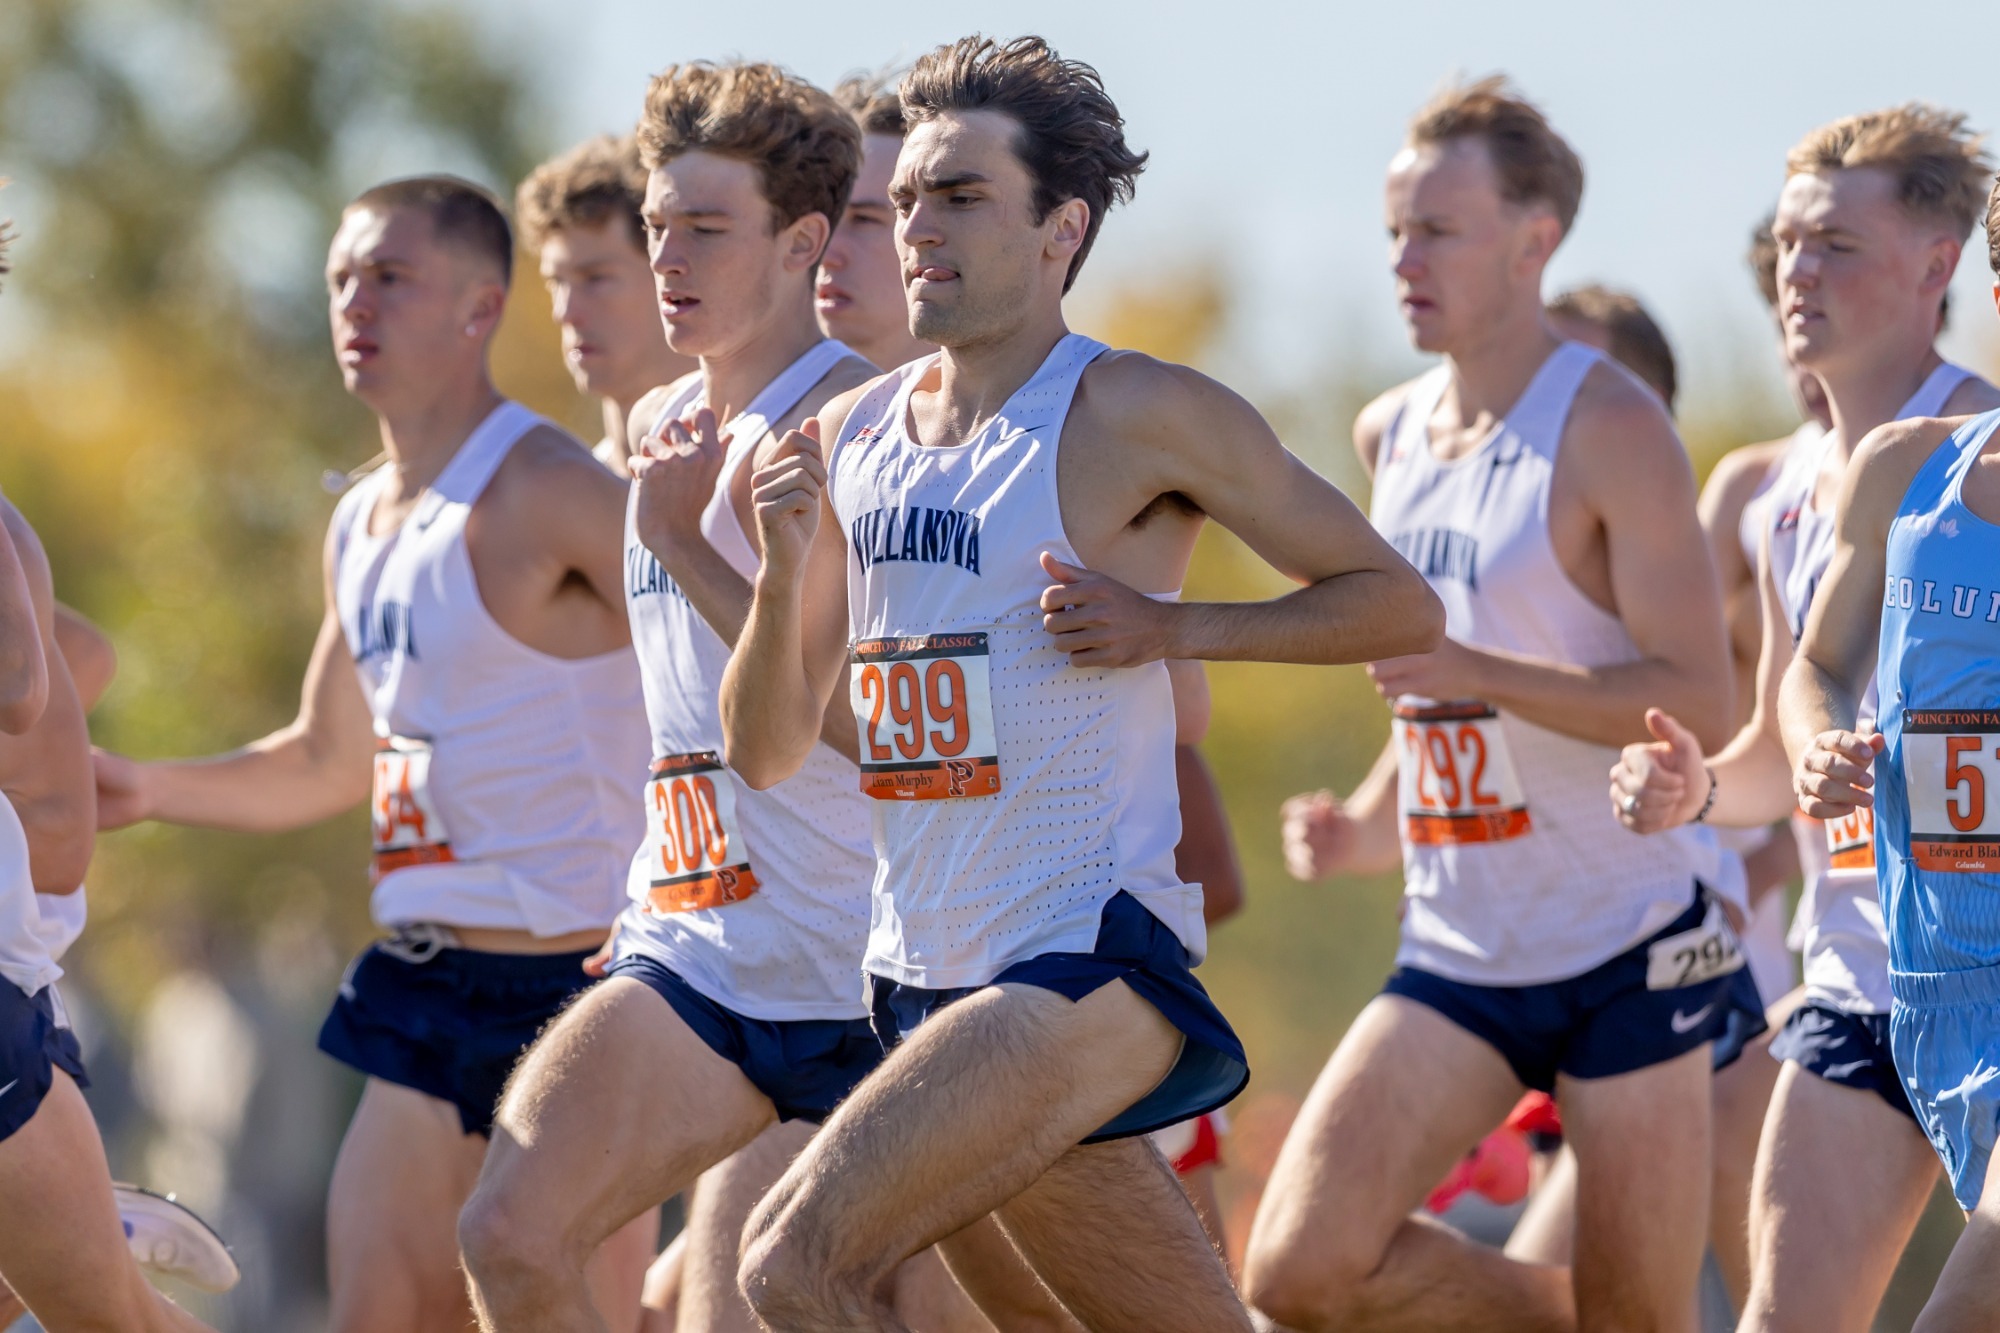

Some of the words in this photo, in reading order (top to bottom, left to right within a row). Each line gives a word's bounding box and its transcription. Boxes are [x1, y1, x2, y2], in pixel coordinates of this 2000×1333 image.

[852, 506, 981, 577] VILLANOVA
[925, 636, 977, 649] CLASSIC
[861, 659, 970, 760] 299
[1912, 713, 1980, 725] PRINCETON
[872, 775, 894, 788] Liam
[895, 772, 934, 789] Murphy
[946, 760, 975, 797] P
[1406, 723, 1499, 808] 292
[1946, 736, 2000, 832] 5
[655, 774, 728, 875] 300
[1929, 844, 1973, 858] Edward
[1672, 935, 1736, 986] 29
